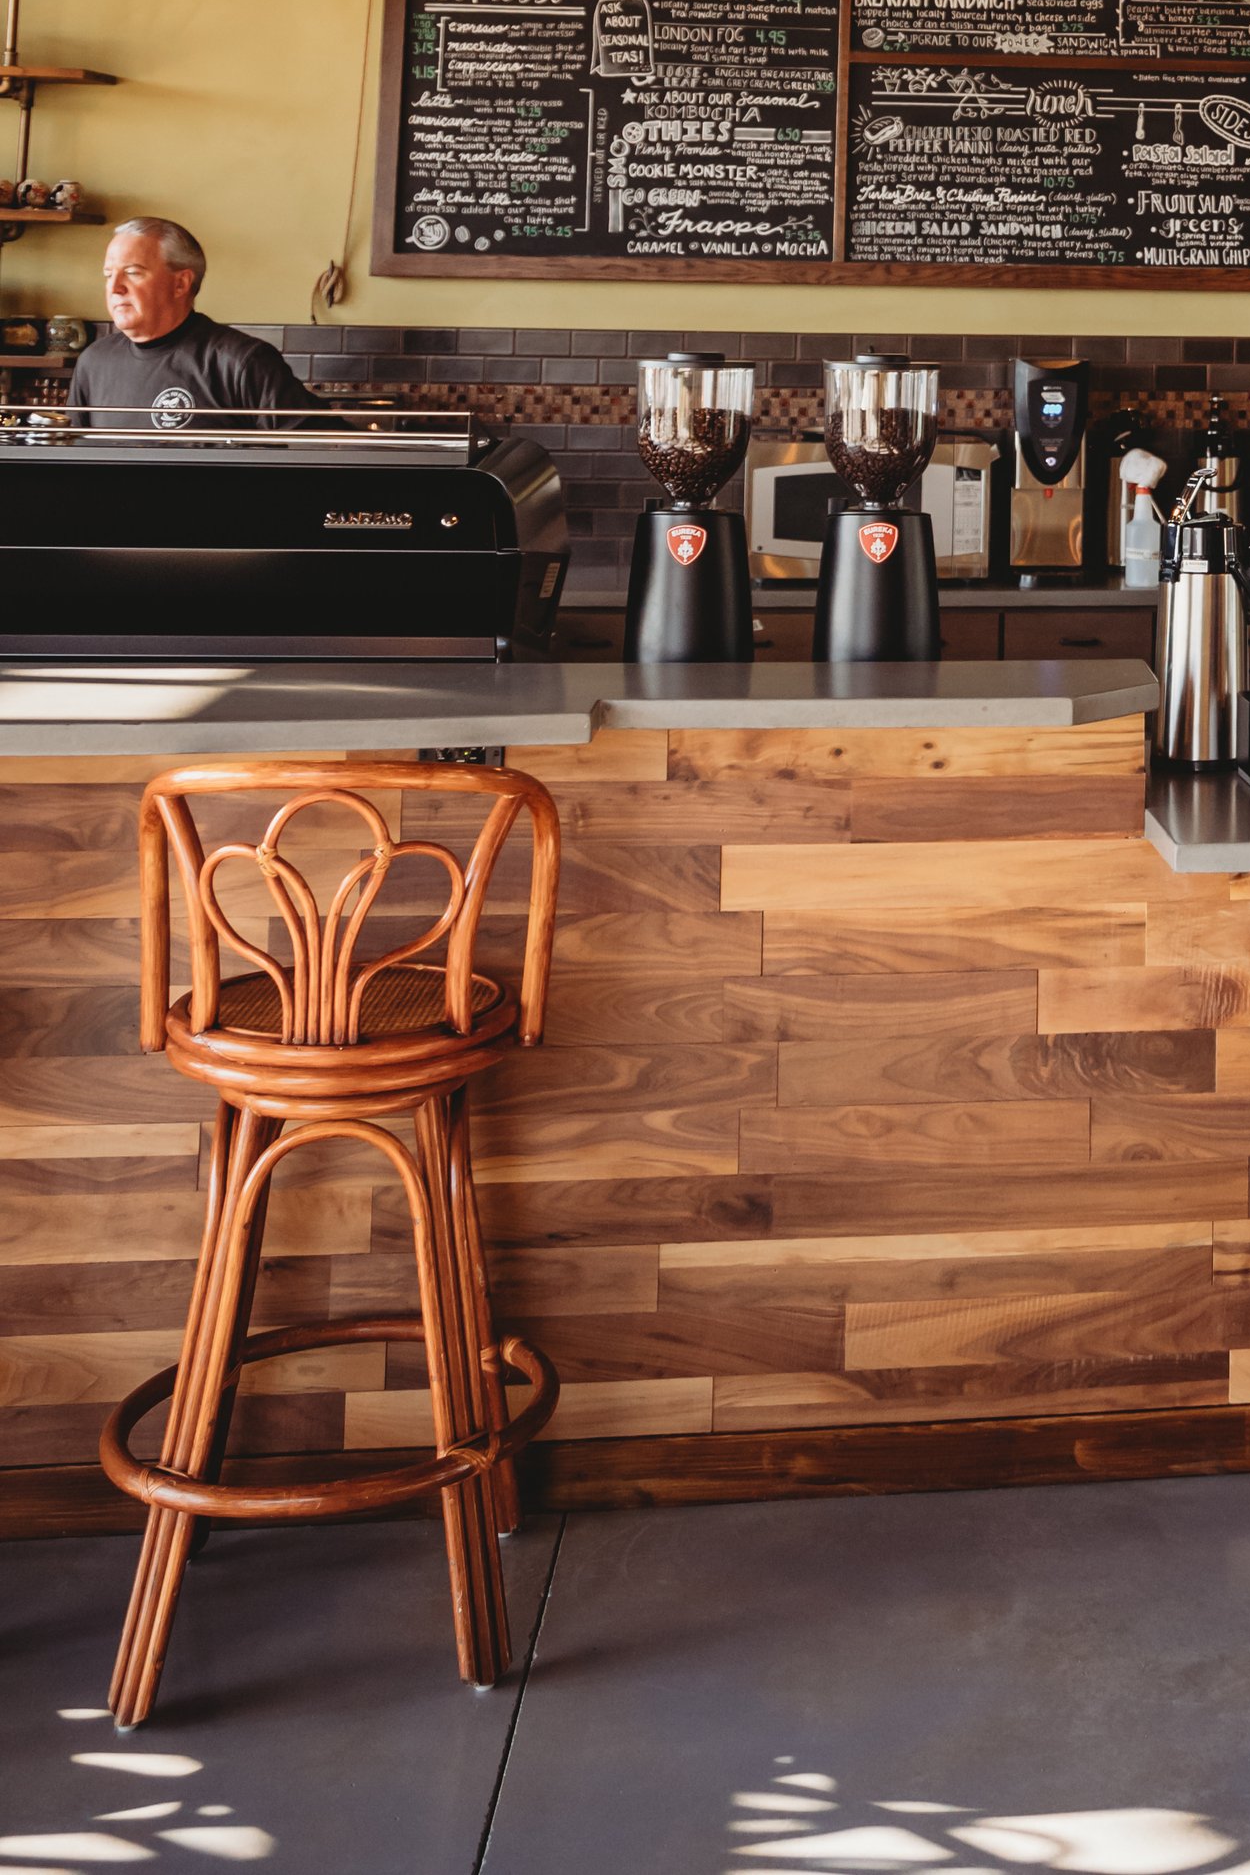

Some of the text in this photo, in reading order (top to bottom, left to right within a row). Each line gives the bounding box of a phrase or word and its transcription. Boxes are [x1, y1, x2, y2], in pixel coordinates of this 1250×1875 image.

[600, 3, 622, 13] ASK
[448, 21, 509, 33] espresso
[605, 16, 641, 27] ABOUT
[600, 35, 649, 46] SEASONAL
[655, 26, 712, 43] LONDON
[717, 27, 744, 43] FOG
[905, 34, 1117, 50] UPGRADE TO OUR POWER SANDWICH
[609, 51, 644, 63] TEAS!
[715, 68, 756, 79] ENGLISH
[664, 77, 815, 90] LEAF EARL GREY GREEN
[637, 90, 820, 108] ASK ABOUT OUR Seasonal
[1026, 87, 1095, 118] lunch
[408, 115, 474, 127] americano
[644, 105, 761, 122] KOMBUCHA
[903, 126, 1097, 143] CHICKEN PESTO ROASTED RED
[459, 148, 538, 162] macchiato
[635, 143, 672, 160] Pinky
[675, 143, 722, 157] Promise
[889, 139, 994, 155] PEPPER PANINI
[1132, 144, 1235, 165] Pasta Salad
[629, 163, 757, 180] COOKIE MONSTER
[510, 182, 539, 193] 5.00
[1043, 177, 1075, 188] 10.75
[622, 188, 644, 205] GO
[648, 188, 700, 207] GREEN
[1136, 190, 1234, 215] FRUIT SALAD
[657, 208, 783, 237] Frappe
[853, 221, 1062, 239] CHICKEN SALAD SANDWICH
[1159, 217, 1244, 239] greens
[627, 240, 829, 256] CARAMEL VANILLA MOCHA
[1143, 246, 1219, 265] MULTI-GRAIN
[671, 527, 701, 537] EUREKA
[864, 526, 893, 535] EUREKA
